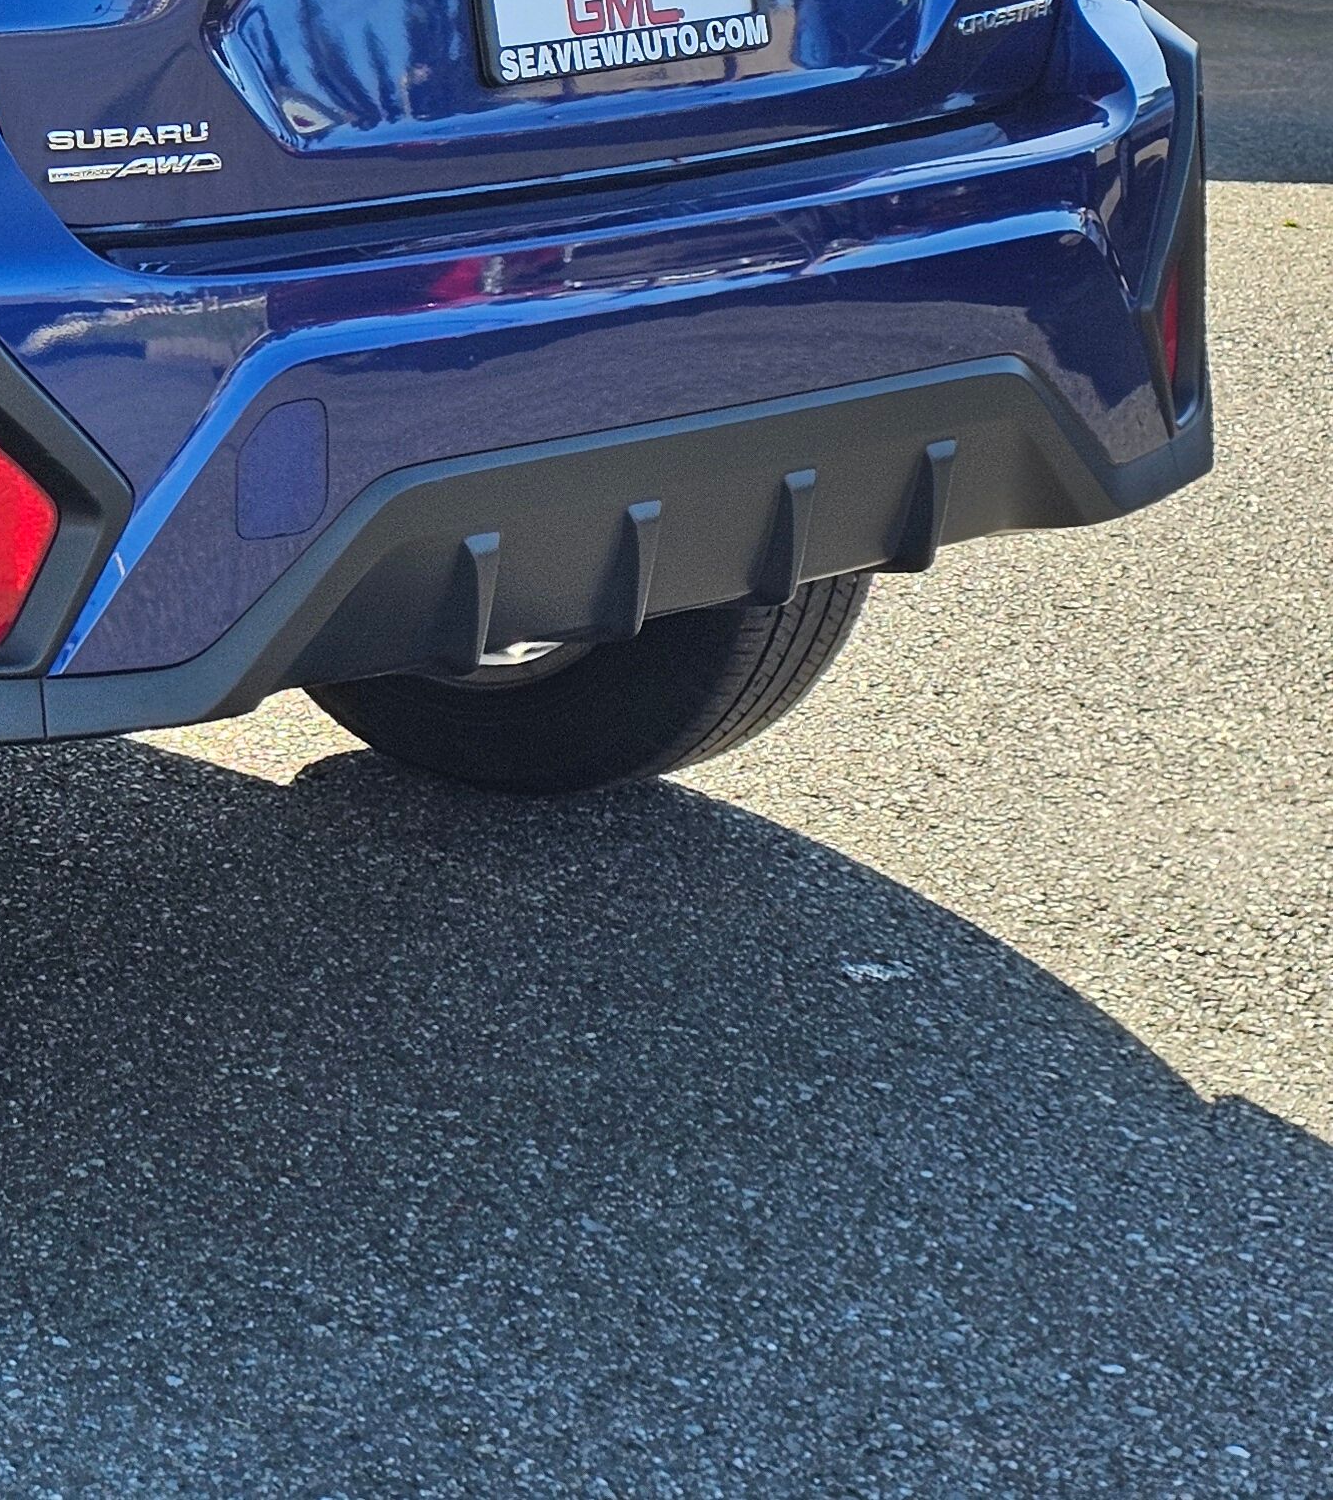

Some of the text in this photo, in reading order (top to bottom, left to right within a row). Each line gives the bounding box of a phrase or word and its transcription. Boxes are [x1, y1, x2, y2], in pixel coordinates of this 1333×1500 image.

[498, 14, 771, 82] SEAVIEWAUTO.COM
[46, 121, 209, 151] SUBARU
[114, 152, 223, 178] AWD
